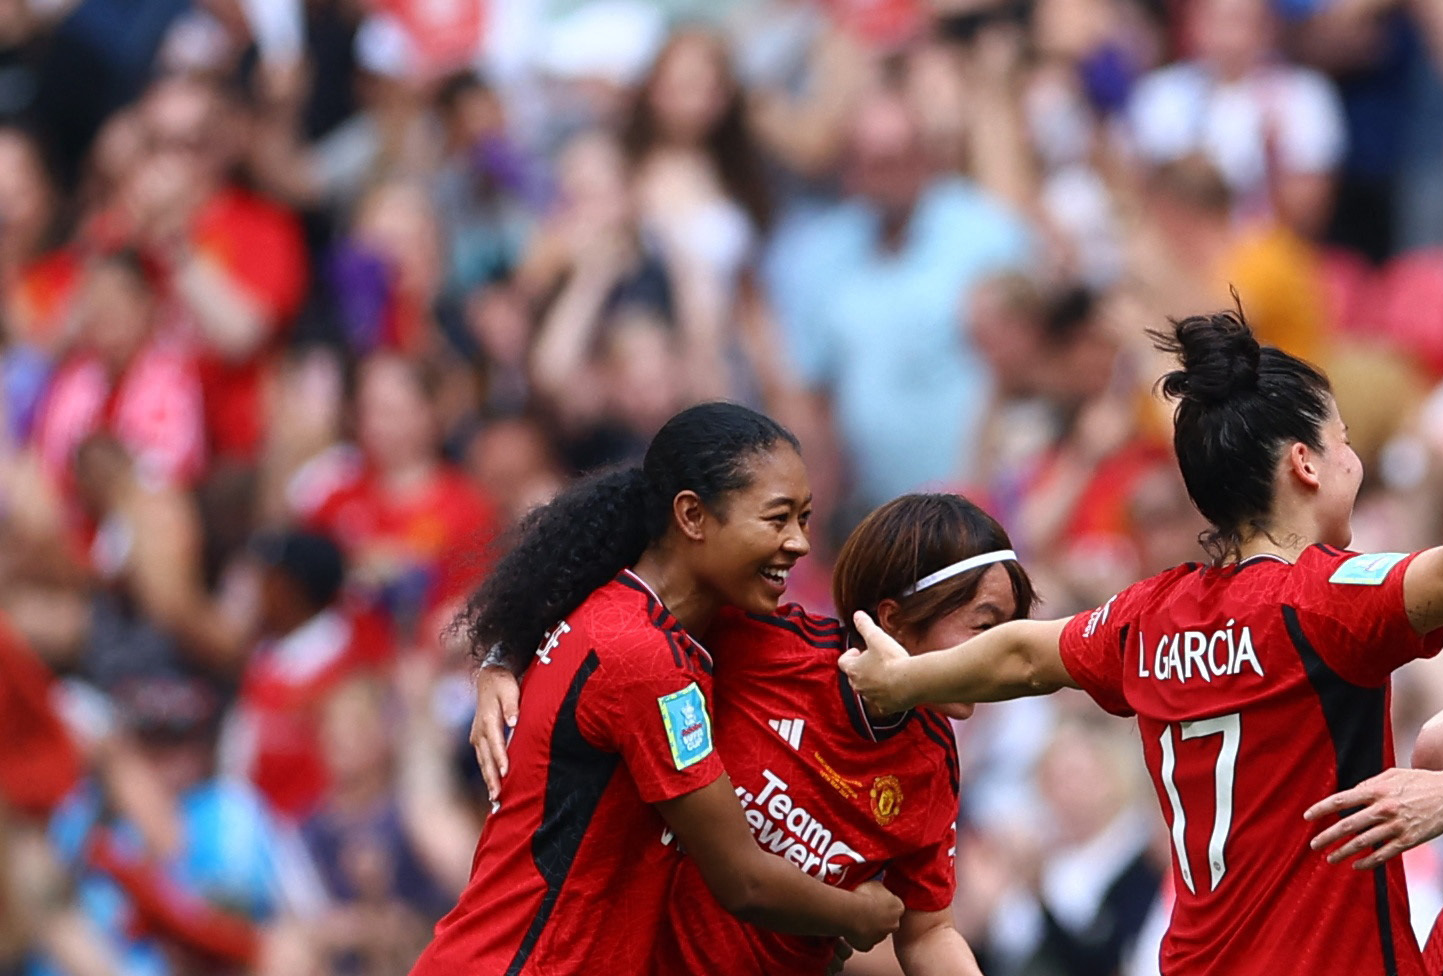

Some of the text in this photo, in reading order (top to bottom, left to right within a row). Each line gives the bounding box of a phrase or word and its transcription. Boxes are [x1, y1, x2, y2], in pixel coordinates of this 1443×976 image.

[1138, 618, 1265, 685] L GARCÍA
[754, 768, 832, 856] Team
[1159, 712, 1241, 896] 17
